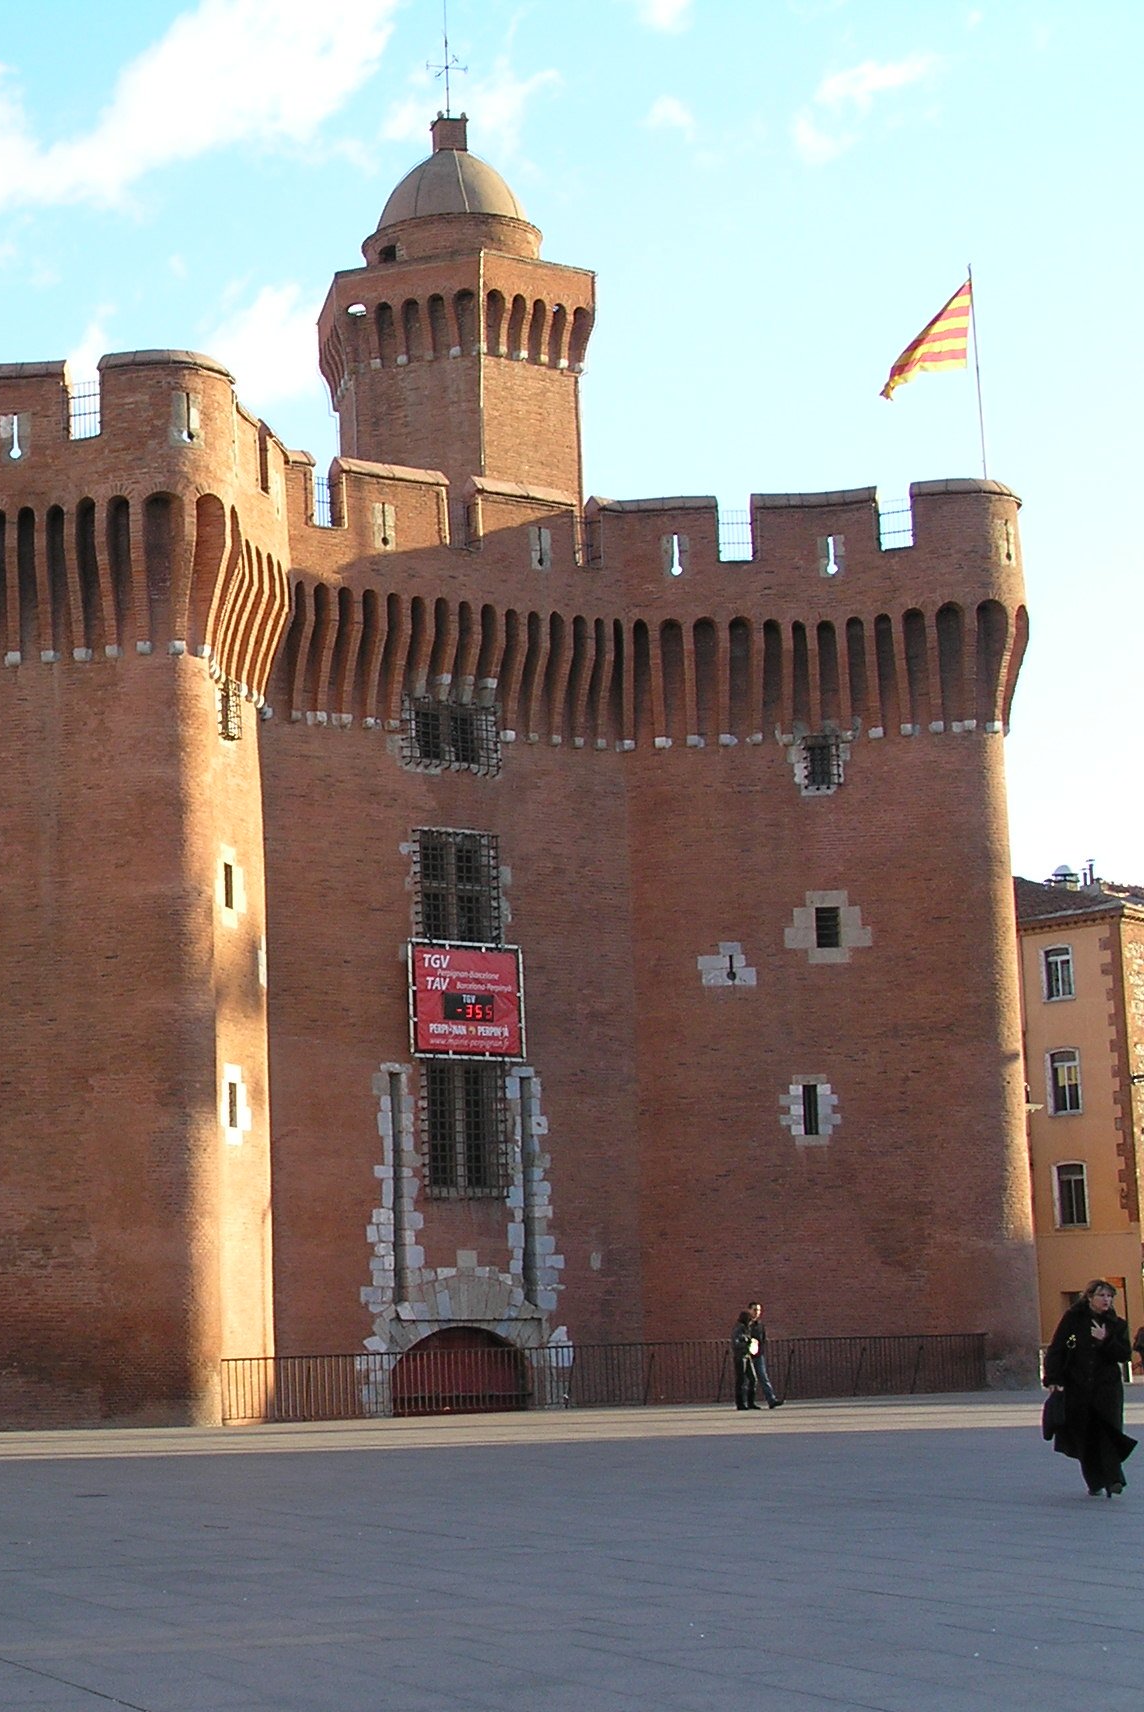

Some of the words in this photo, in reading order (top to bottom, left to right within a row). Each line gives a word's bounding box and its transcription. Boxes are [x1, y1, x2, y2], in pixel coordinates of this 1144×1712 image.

[423, 954, 450, 968] TGV
[426, 977, 449, 990] TAV
[462, 994, 476, 1003] TGV
